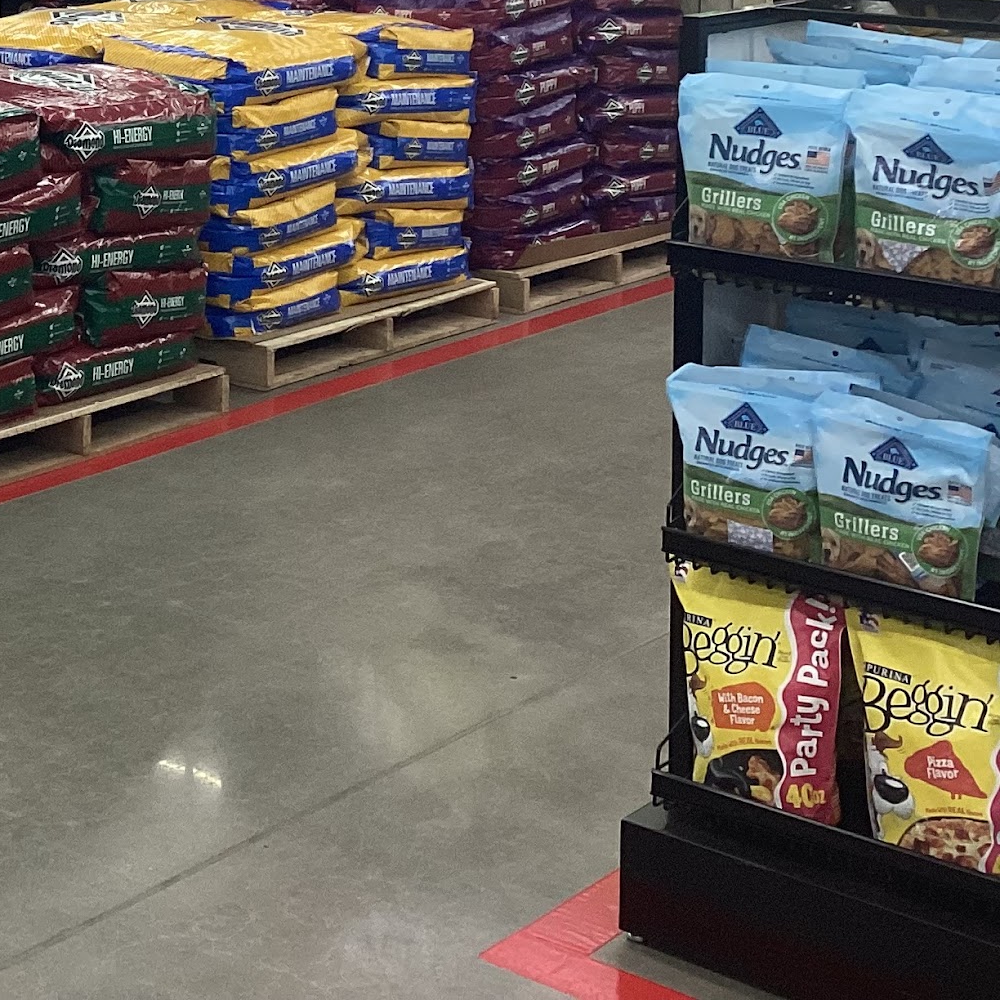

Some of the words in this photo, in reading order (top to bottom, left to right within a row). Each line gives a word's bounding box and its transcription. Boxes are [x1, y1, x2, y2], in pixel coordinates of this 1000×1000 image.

[285, 63, 335, 84] MAINTENANCE
[390, 90, 437, 106] MAINTENANCE
[64, 137, 105, 150] Diamond
[112, 126, 153, 145] HI-ENERGY
[709, 133, 801, 174] Nudges
[289, 159, 337, 184] MAINTENANCE
[872, 155, 979, 199] Nudges
[388, 181, 435, 196] MAINTENANCE
[701, 187, 762, 211] Grillers
[871, 211, 937, 236] Grillers
[41, 260, 82, 274] Diamond
[90, 250, 134, 269] HI-ENERGY
[291, 251, 337, 276] MAINTENANCE
[387, 266, 433, 287] MAINTENANCE
[92, 358, 134, 381] HI-ENERGY
[50, 372, 85, 390] Diamond
[734, 420, 757, 430] BLUE
[695, 426, 789, 470] Nudges
[882, 452, 904, 464] BLUE
[842, 456, 942, 503] Nudges
[690, 480, 751, 506] Grillers
[834, 512, 899, 541] Grillers
[686, 613, 711, 627] RINA
[797, 597, 838, 688] Pack!
[866, 663, 910, 684] PURINA
[717, 692, 736, 703] With
[737, 693, 763, 704] Bacon
[862, 675, 994, 737] Beggin'
[723, 703, 730, 713] &
[731, 703, 761, 715] Cheese
[729, 714, 755, 725] Flavor
[789, 695, 829, 777] Party
[926, 755, 955, 769] Pizza
[927, 768, 959, 780] Flavor
